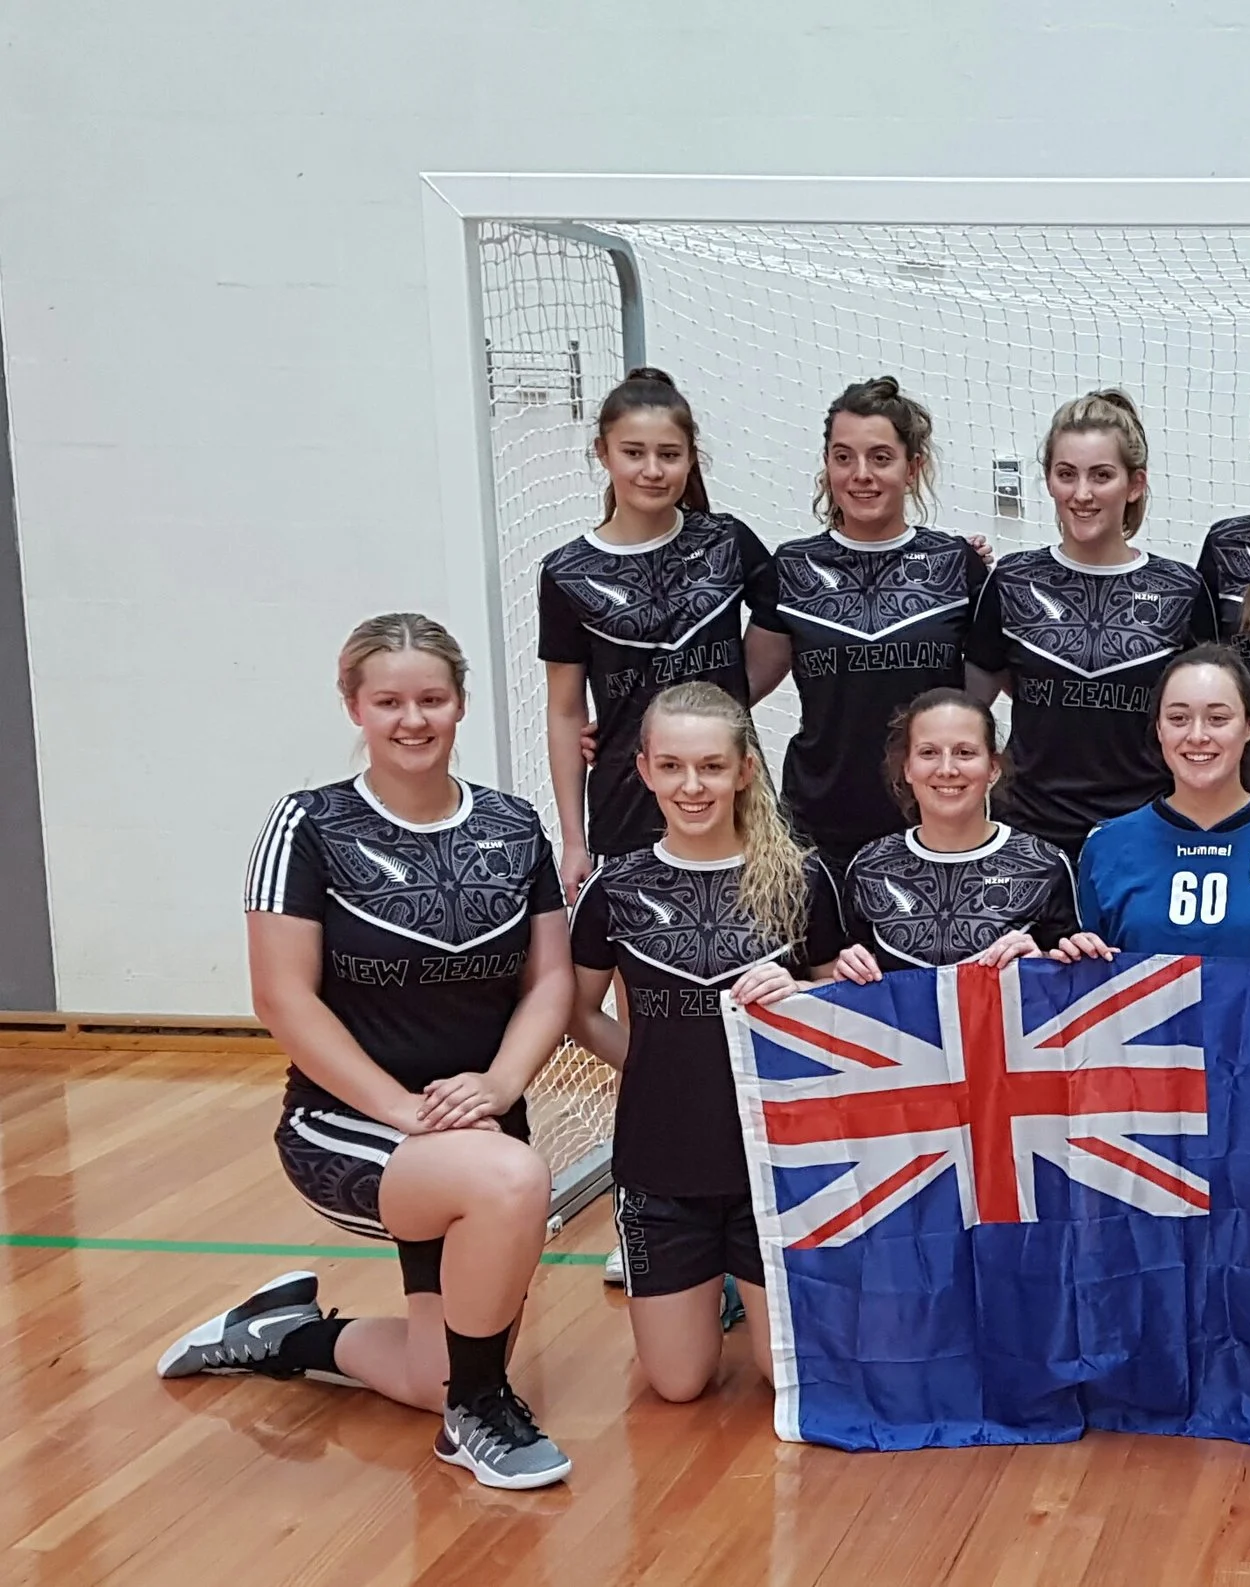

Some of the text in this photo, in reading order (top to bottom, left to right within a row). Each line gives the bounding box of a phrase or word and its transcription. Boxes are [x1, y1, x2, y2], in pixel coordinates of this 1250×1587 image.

[1134, 592, 1159, 602] NZHF
[1019, 678, 1151, 714] EW ZEALA
[477, 840, 504, 850] NZHF
[1176, 844, 1233, 857] hummel
[984, 877, 1010, 886] NZHF
[1168, 870, 1229, 925] 60
[332, 948, 528, 987] NEW ZEALA
